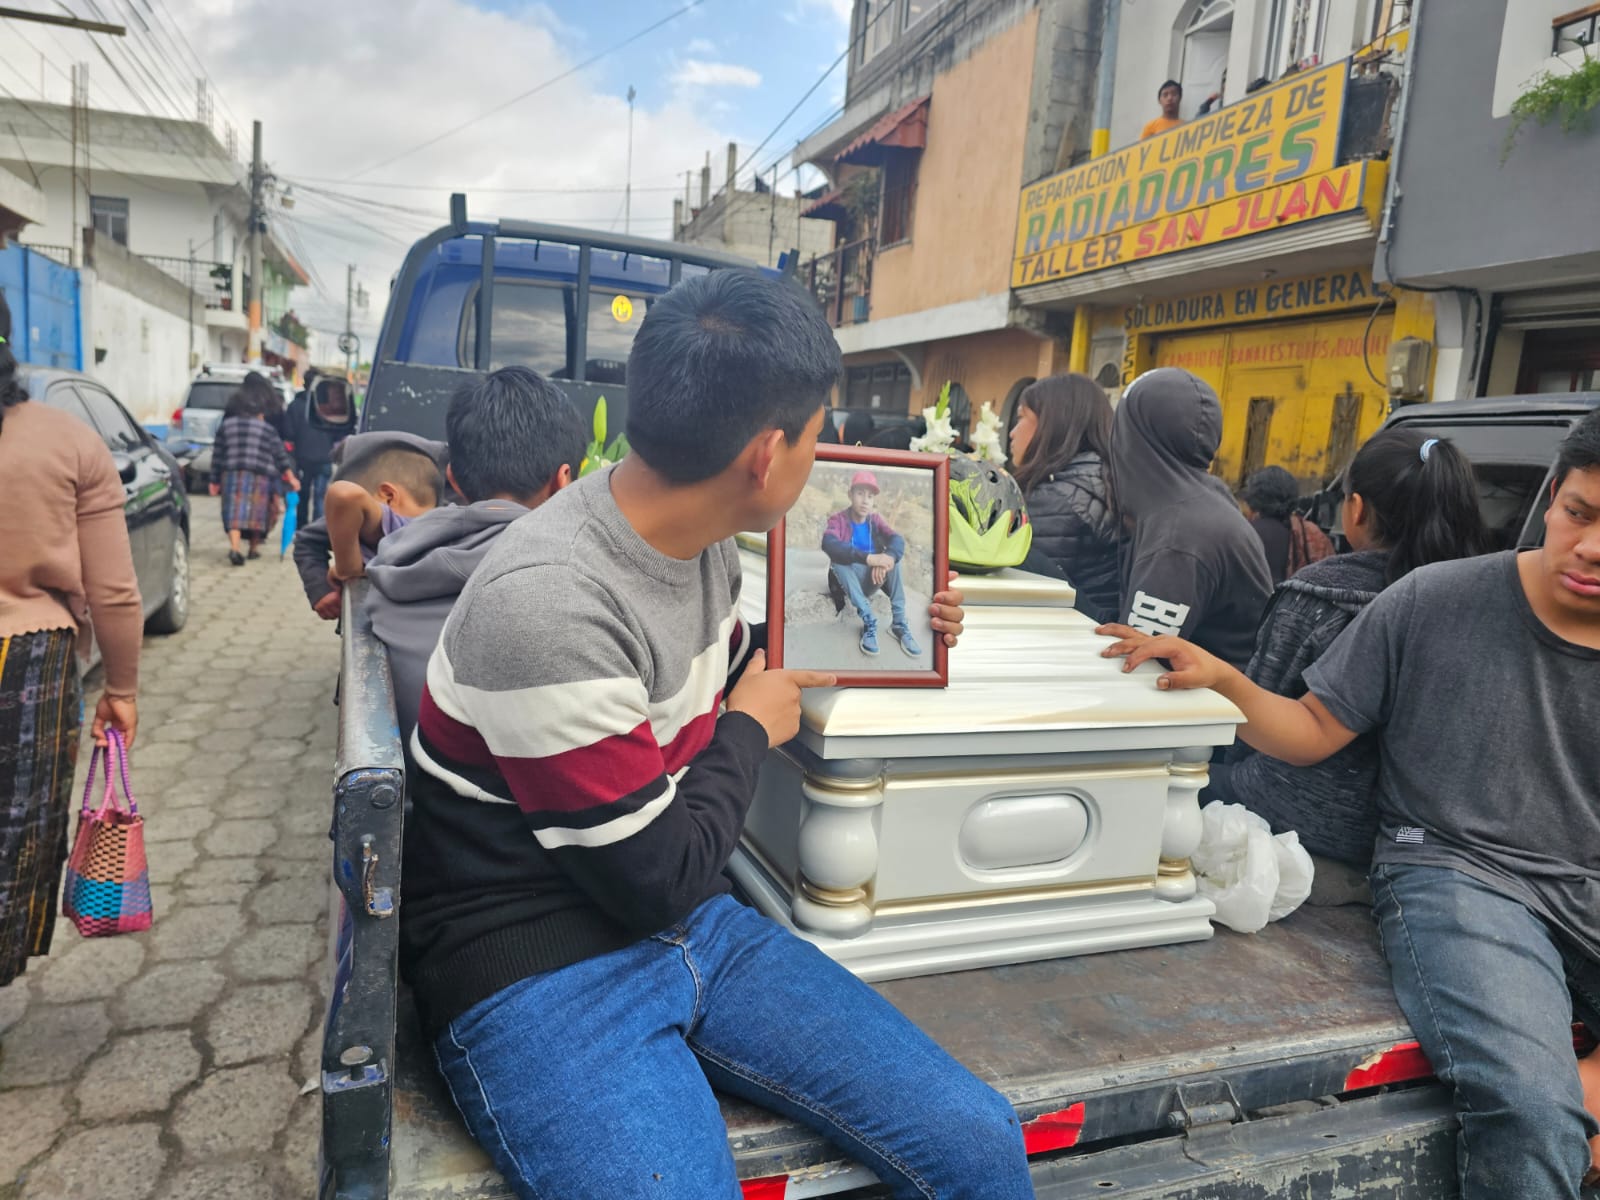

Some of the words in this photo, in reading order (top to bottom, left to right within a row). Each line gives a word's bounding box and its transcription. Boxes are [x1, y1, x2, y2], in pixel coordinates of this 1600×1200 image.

[1023, 112, 1325, 256] RADIADORES
[1025, 152, 1130, 212] REPARACION
[1139, 144, 1152, 171] Y
[1158, 96, 1274, 164] LIMPIEZA
[1285, 75, 1327, 120] DE
[1020, 234, 1122, 283] TALLER
[1134, 205, 1210, 257] SAN
[1222, 169, 1351, 236] JUAN
[1124, 293, 1225, 329] SOLDADURA
[1234, 287, 1258, 315] EN
